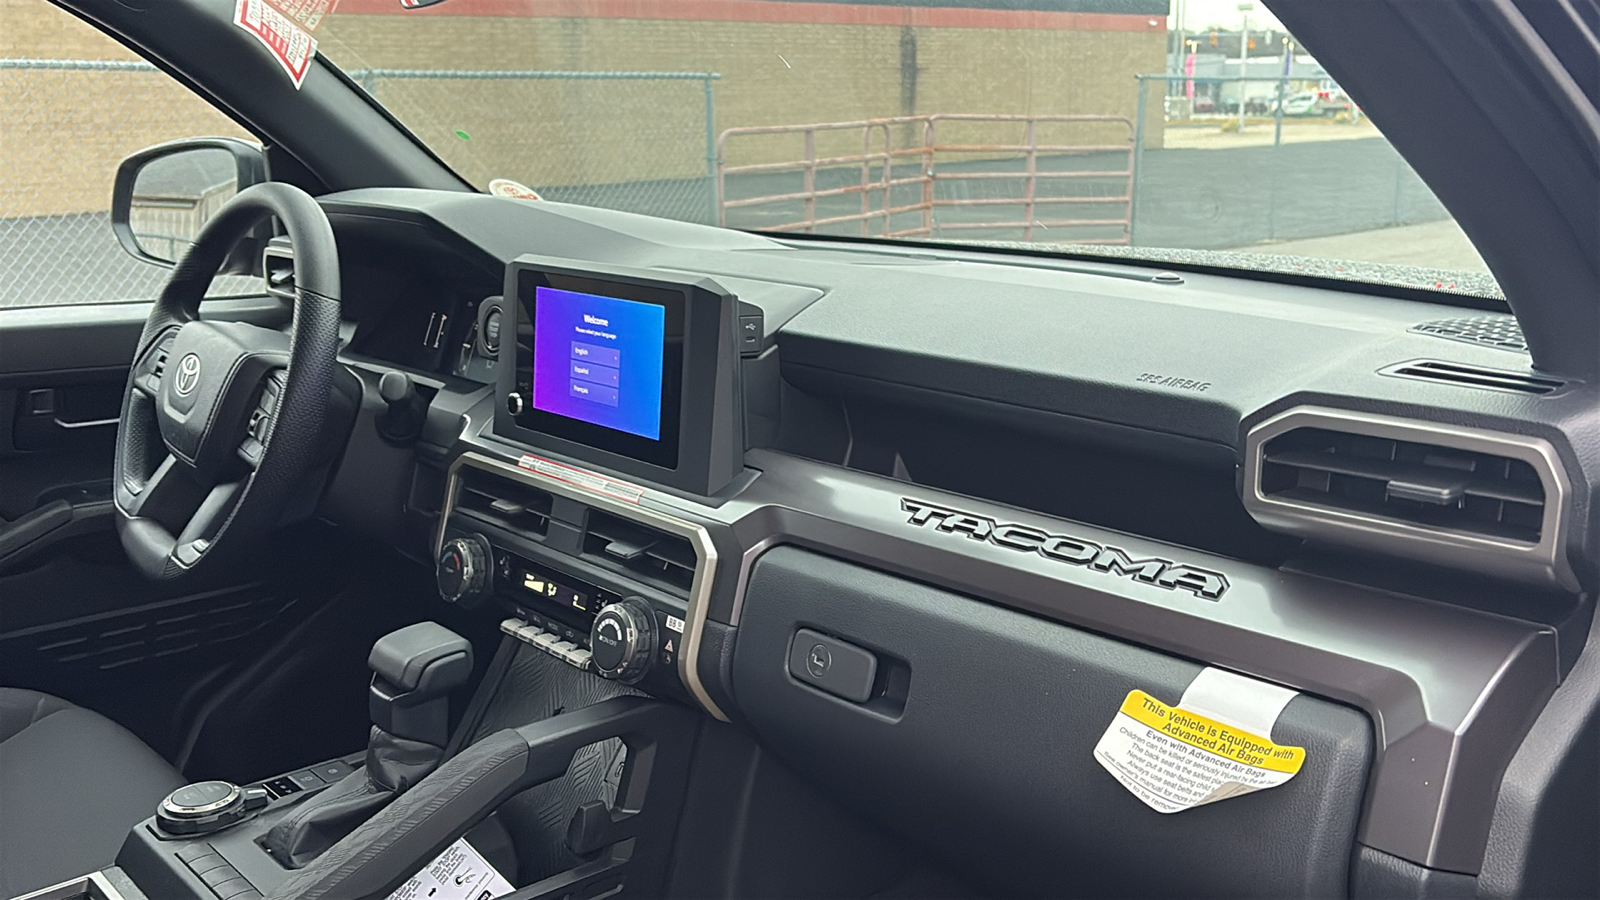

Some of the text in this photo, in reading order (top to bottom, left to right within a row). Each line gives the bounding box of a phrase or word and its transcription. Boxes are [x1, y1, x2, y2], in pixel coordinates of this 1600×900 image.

[583, 314, 608, 327] Welcome
[574, 347, 588, 356] English
[900, 497, 1231, 602] TACOMA
[1142, 697, 1166, 717] This
[1168, 711, 1206, 733] Vehicle
[1219, 730, 1273, 756] Equipped
[1273, 749, 1294, 760] with
[1162, 722, 1264, 765] Advanced Air Bags
[1119, 726, 1145, 744] Children
[1146, 741, 1158, 751] can
[1159, 747, 1168, 755] be
[1168, 751, 1186, 762] killed
[1192, 761, 1220, 776] seriously
[1127, 750, 1146, 763] Never
[1145, 761, 1157, 770] put
[1132, 742, 1144, 753] The
[1144, 749, 1160, 761] back
[1160, 758, 1175, 768] seat
[1181, 766, 1192, 775] the
[1192, 771, 1212, 782] safest
[1146, 730, 1266, 778] Even with Advanced Air Bags
[1127, 760, 1149, 776] Always
[1150, 773, 1163, 782] use
[1162, 779, 1178, 789] seat
[1177, 784, 1192, 795] belts
[1139, 777, 1164, 793] manual
[1163, 788, 1173, 797] for
[1140, 791, 1150, 800] be
